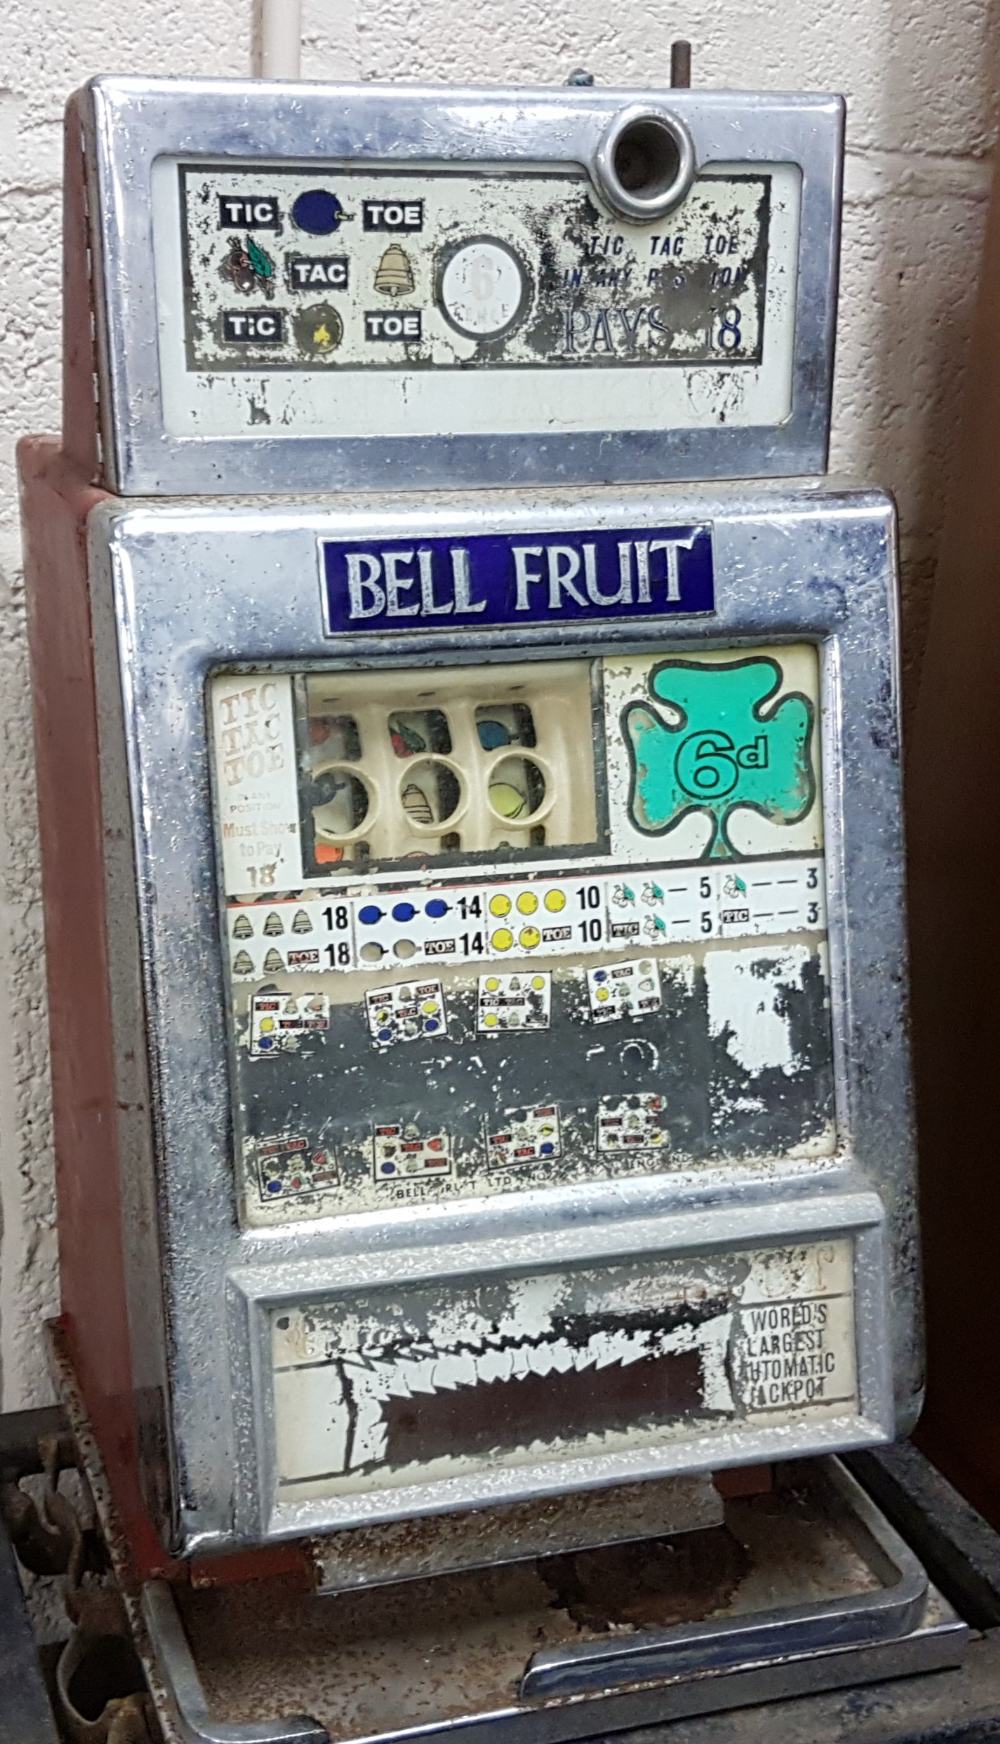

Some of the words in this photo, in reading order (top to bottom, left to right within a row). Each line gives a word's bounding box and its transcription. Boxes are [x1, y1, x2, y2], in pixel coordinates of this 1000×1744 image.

[225, 202, 275, 223] TIC
[367, 205, 421, 226] TOE
[590, 236, 624, 256] TIC
[650, 236, 685, 256] TAC
[704, 236, 739, 256] TOE
[294, 264, 347, 284] TAC
[229, 317, 276, 336] TIC
[367, 317, 420, 336] TOE
[345, 547, 488, 620] BELL
[511, 534, 694, 611] FRUIT
[220, 682, 277, 726] TIC
[224, 743, 285, 787] TOE
[674, 730, 769, 800] 6d
[246, 862, 276, 888] 18
[806, 867, 818, 889] 3
[576, 886, 601, 910] 10
[700, 876, 712, 899] 5
[322, 906, 349, 931] 18
[457, 896, 482, 920] 14
[722, 910, 749, 924] TIC
[807, 902, 819, 924] 3
[542, 928, 572, 942] TOE
[579, 918, 601, 943] 10
[611, 922, 640, 937] TIC
[701, 911, 712, 934] 5
[288, 950, 319, 965] TOE
[325, 942, 350, 967] 18
[425, 939, 456, 955] TOE
[459, 932, 484, 956] 14
[396, 1185, 426, 1199] BELL
[487, 1175, 512, 1188] LTD
[751, 1303, 828, 1333] WORLD'S
[747, 1328, 825, 1358] LARGEST
